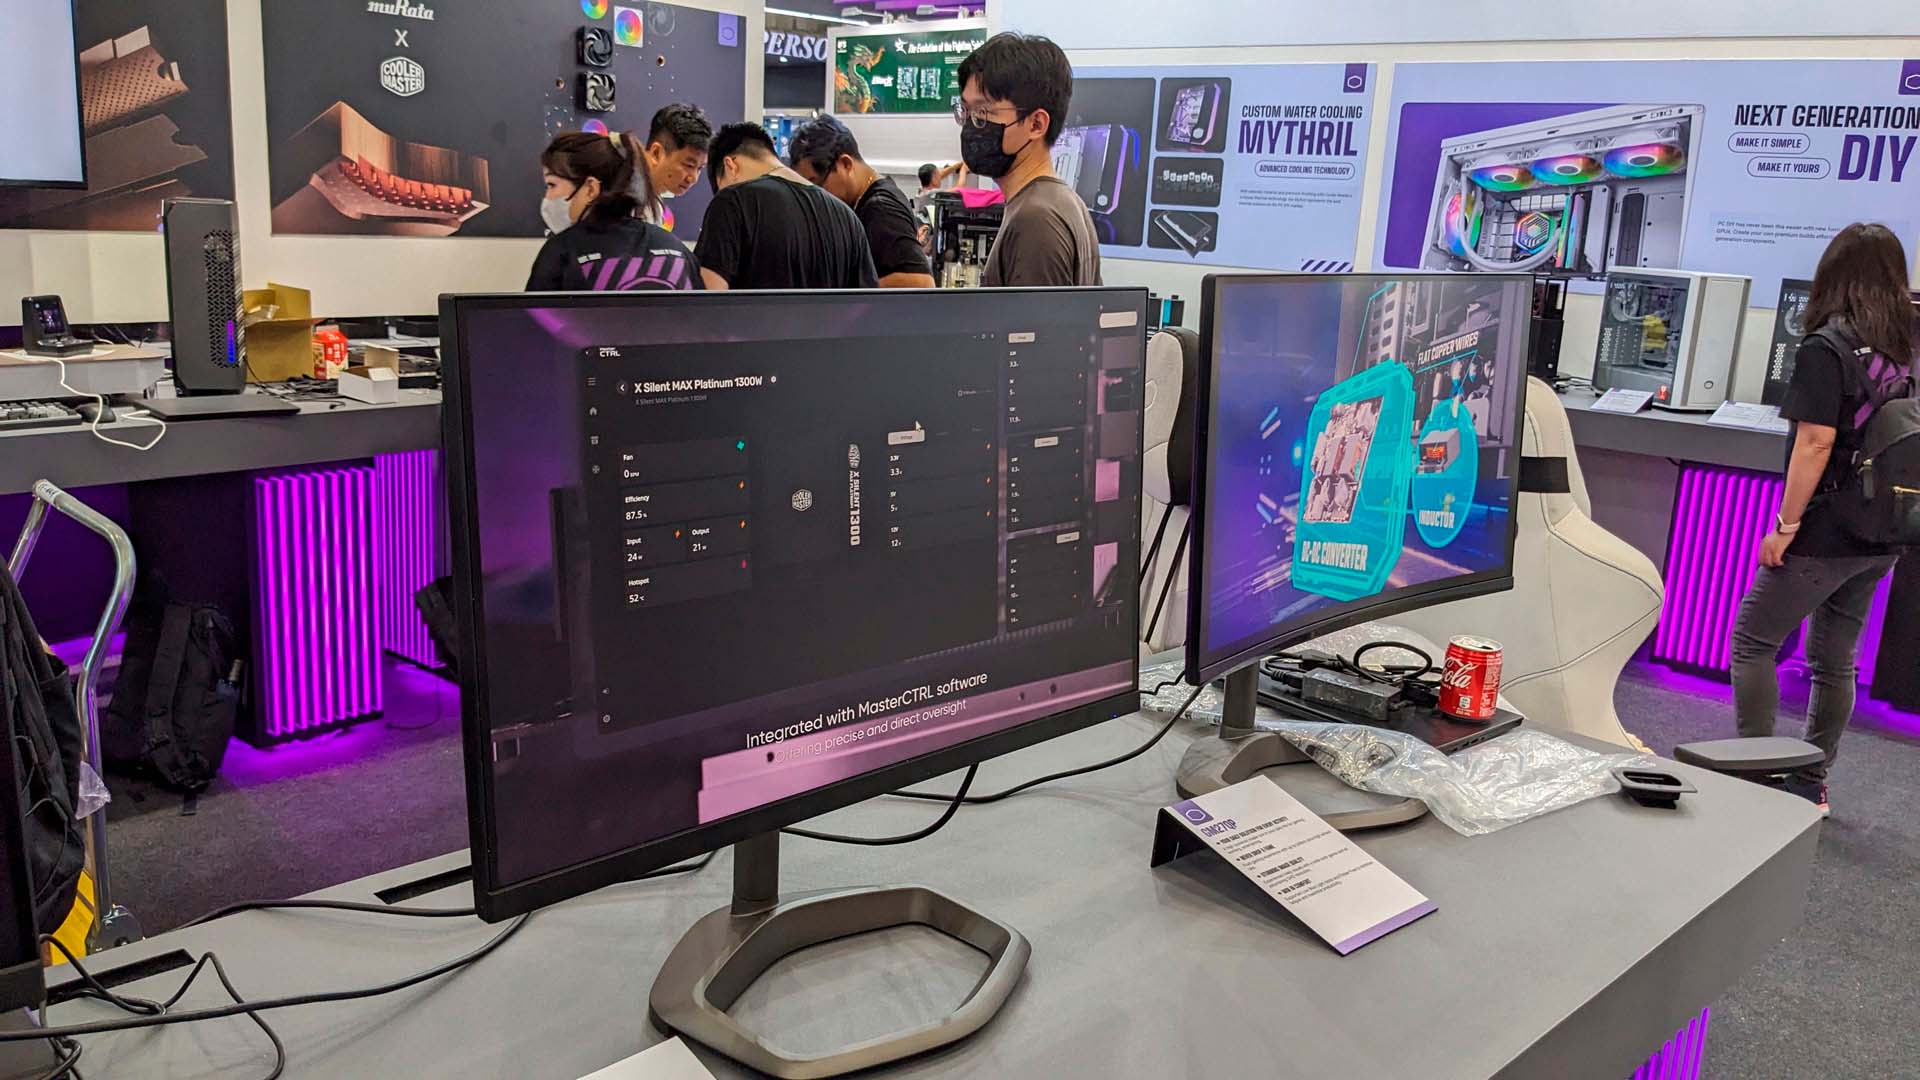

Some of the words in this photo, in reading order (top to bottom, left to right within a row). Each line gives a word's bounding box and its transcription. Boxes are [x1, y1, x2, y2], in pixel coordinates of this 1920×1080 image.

[395, 29, 408, 47] X
[383, 60, 422, 78] COOLER
[383, 75, 422, 93] MASTER
[1242, 105, 1281, 118] CUSTOM
[1284, 105, 1317, 118] WATER
[1320, 105, 1363, 119] COOLING
[1734, 104, 1788, 127] NEXT
[1791, 105, 1920, 129] GENERATION
[1238, 120, 1358, 156] MYTHRIL
[1736, 138, 1760, 148] MAKE
[1761, 139, 1770, 148] IT
[1770, 139, 1802, 149] SIMPLE
[1838, 134, 1918, 182] DIY
[1259, 165, 1288, 174] ADVANCED
[1288, 166, 1313, 174] COOLING
[1313, 166, 1350, 176] TECHNOLOGY
[1757, 162, 1782, 172] MAKE
[1783, 163, 1792, 172] IT
[1793, 163, 1820, 174] YOURS
[1417, 349, 1432, 366] FLAT
[1431, 339, 1455, 361] COPPER
[1455, 331, 1479, 352] WIRES
[635, 383, 642, 394] X
[643, 381, 671, 393] Silent
[672, 379, 693, 391] MAX
[694, 378, 733, 390] Platinum
[734, 376, 763, 387] 1300W
[624, 469, 630, 478] 0
[625, 494, 650, 503] Efficiency
[850, 509, 860, 546] 1300
[1419, 510, 1455, 528] INDUCTOR
[692, 527, 710, 537] Output
[627, 537, 641, 546] Input
[1321, 542, 1369, 571] CONVERTER
[628, 577, 650, 587] Hotspot
[746, 713, 823, 749] Integrated
[826, 706, 855, 727] with
[858, 685, 934, 718] MasterCTRL
[936, 673, 988, 697] software
[825, 730, 864, 752] precise
[867, 720, 888, 737] and
[890, 713, 920, 730] direct
[922, 699, 967, 721] oversight
[1201, 818, 1237, 838] GM27QP
